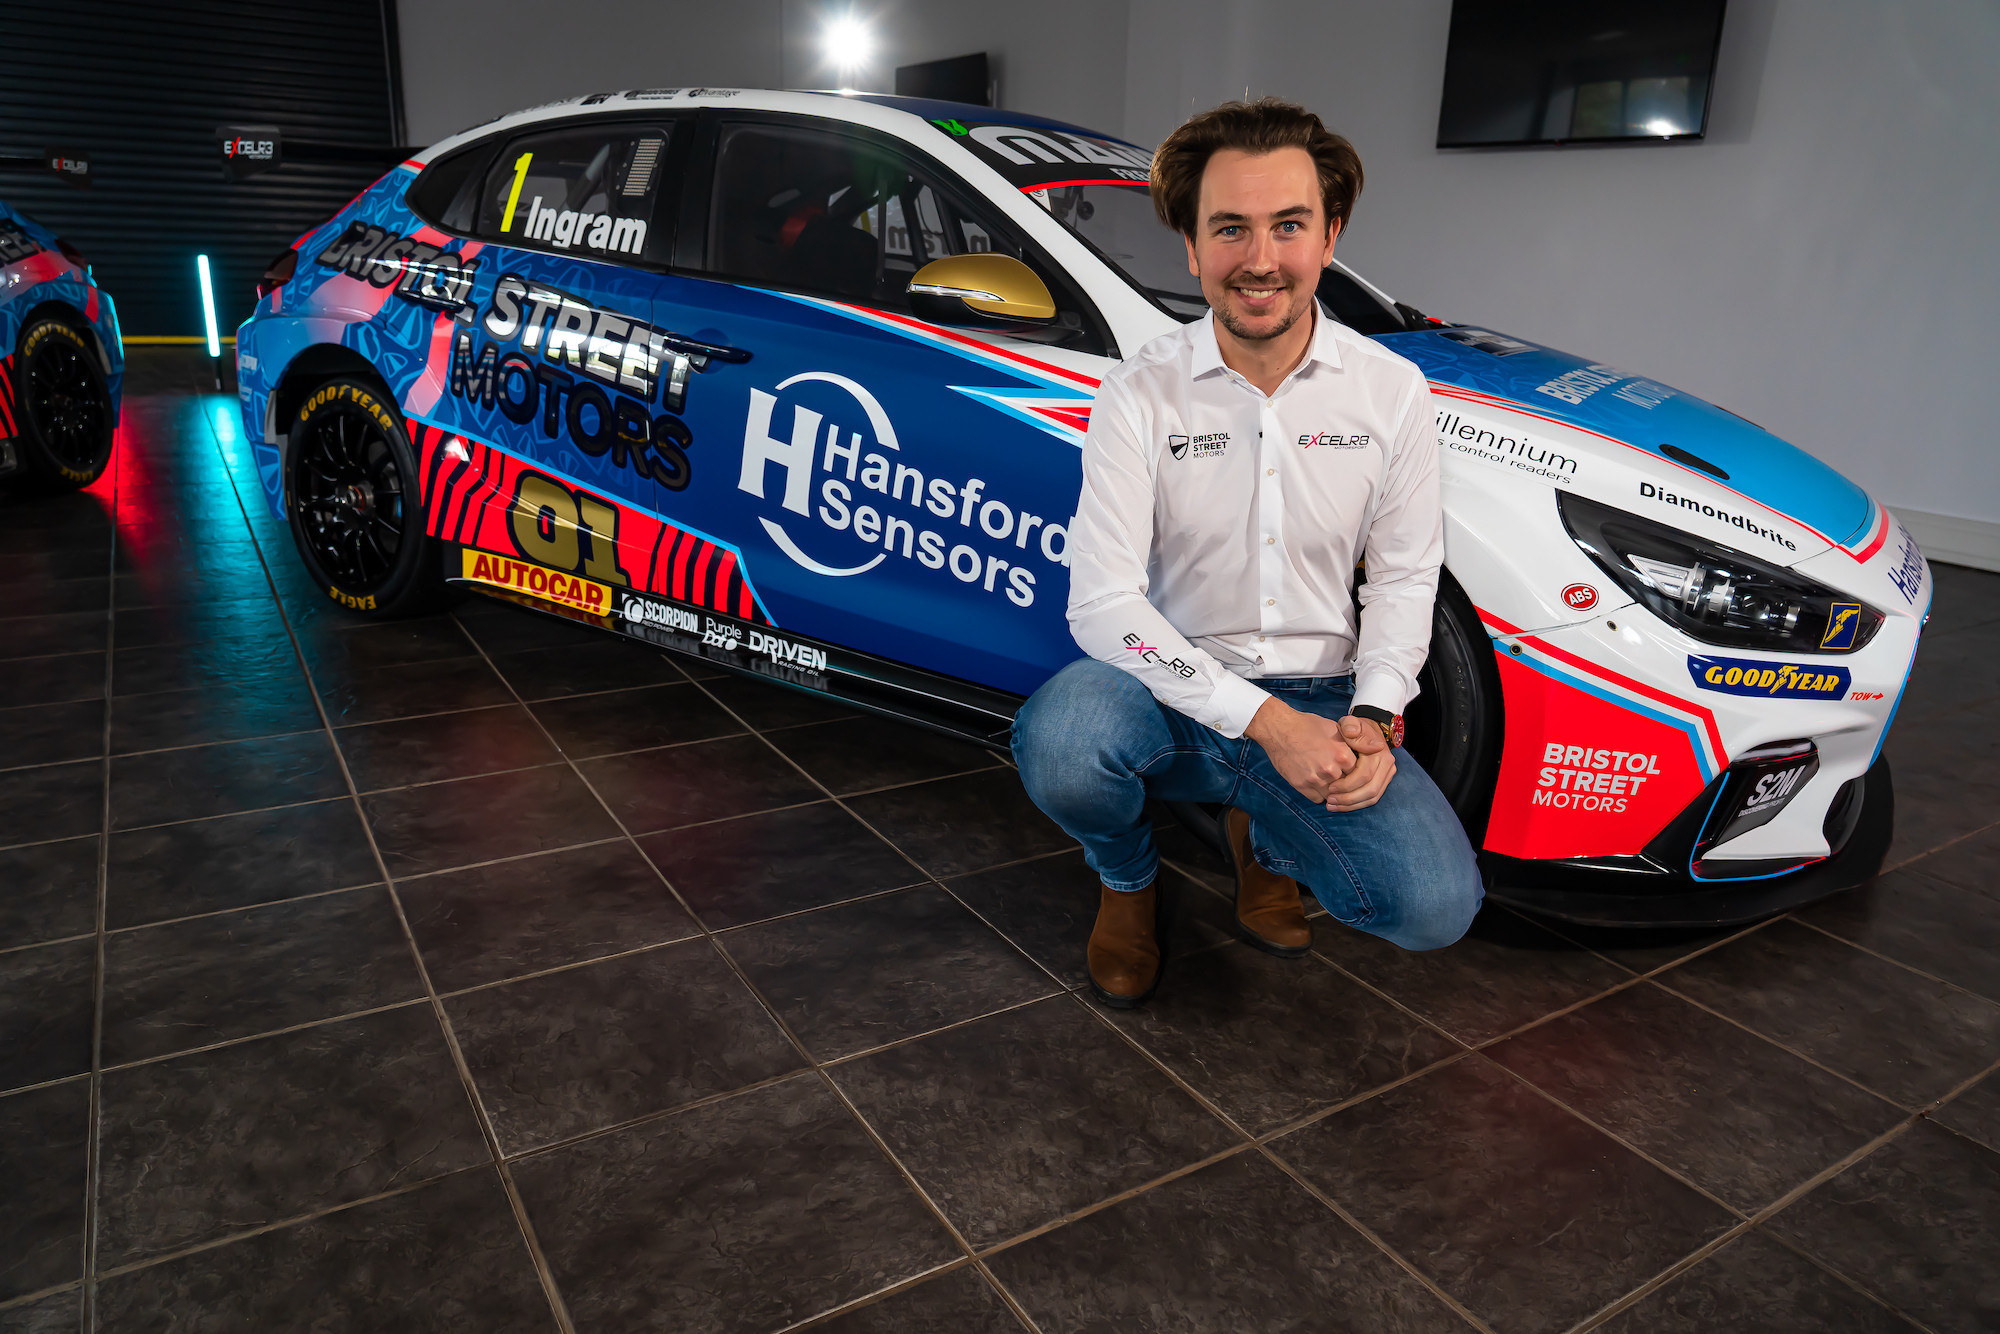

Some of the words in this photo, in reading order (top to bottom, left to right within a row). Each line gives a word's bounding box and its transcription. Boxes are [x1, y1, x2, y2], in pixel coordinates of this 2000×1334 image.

[500, 152, 534, 233] 1
[523, 195, 648, 255] Ingram
[315, 221, 480, 326] BRISTOL
[483, 273, 699, 414] STREET
[300, 384, 393, 431] GOODYEAR
[452, 330, 693, 490] MOTORS
[737, 387, 824, 518] H
[1193, 432, 1231, 444] BRISTOL
[1193, 441, 1228, 452] STREET
[1193, 450, 1225, 459] MOTORS
[1298, 431, 1370, 449] EXCELR8
[1436, 411, 1578, 474] illennium
[1449, 442, 1505, 464] control
[1510, 457, 1571, 485] readers
[823, 423, 1076, 567] Hansford
[508, 471, 631, 588] 01
[1640, 481, 1797, 551] Diamondbrite
[818, 479, 1037, 608] Sensors
[329, 585, 377, 611] EAGLE
[472, 554, 604, 613] AUTOCAR
[1568, 587, 1593, 606] ABS
[643, 600, 699, 633] SCORPION
[706, 616, 742, 639] Purple
[702, 630, 726, 648] Dot
[749, 630, 827, 671] DRIVEN
[1122, 632, 1196, 679] EXCR8
[777, 660, 805, 673] RACING
[806, 669, 820, 677] OIL
[1704, 665, 1840, 693] GOODYEAR
[1850, 691, 1872, 701] TOW
[1543, 742, 1661, 775] BRISTOL
[1531, 788, 1628, 813] MOTORS
[1537, 767, 1647, 796] STREET
[1746, 765, 1807, 807] S2M
